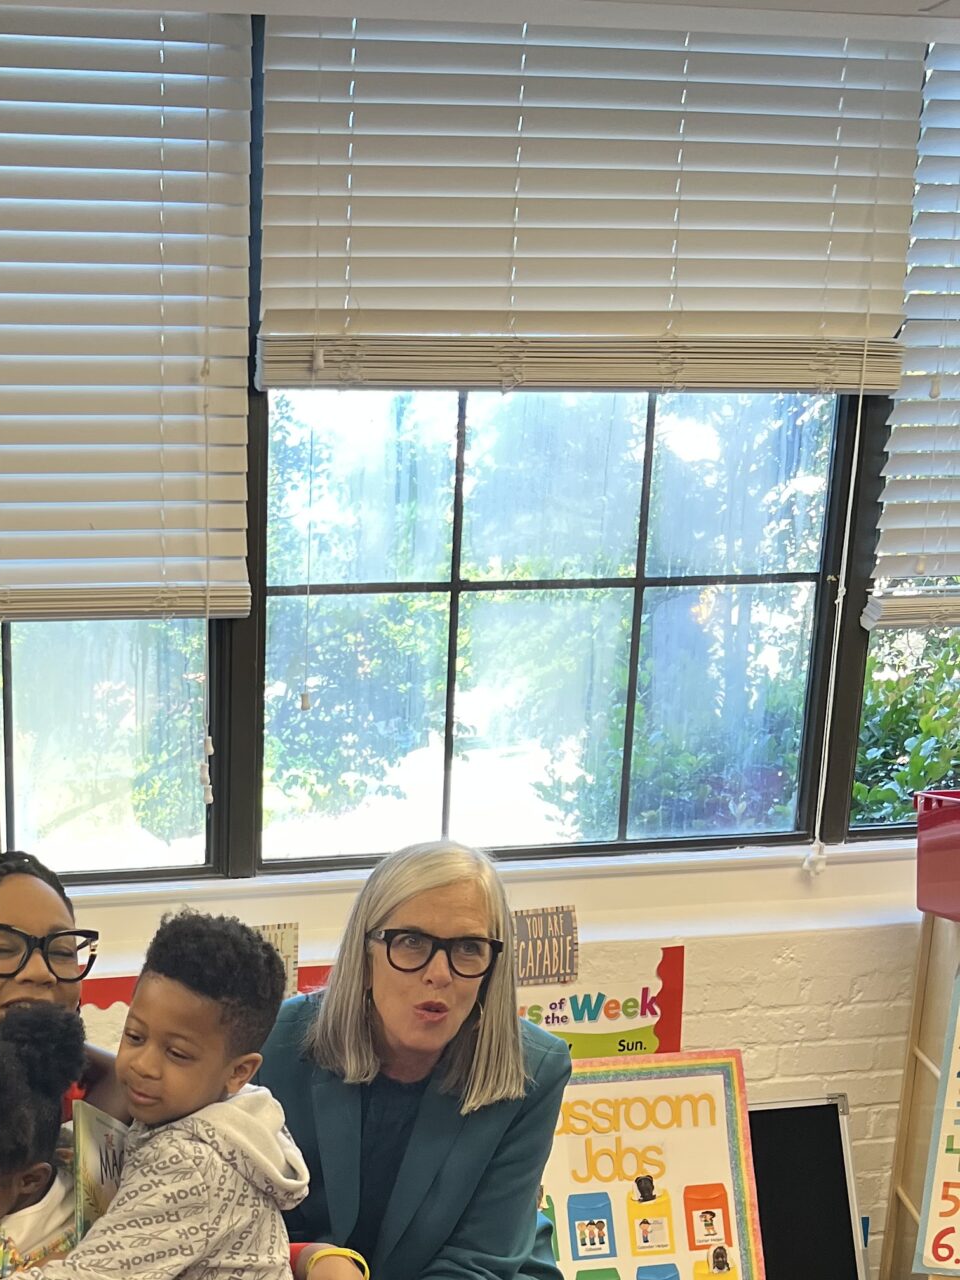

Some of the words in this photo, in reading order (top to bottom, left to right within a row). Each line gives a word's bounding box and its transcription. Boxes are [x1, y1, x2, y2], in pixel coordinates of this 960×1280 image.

[526, 915, 543, 938] YOU
[547, 913, 564, 936] ARE
[518, 936, 572, 979] CAPABLE
[549, 998, 565, 1012] of
[569, 986, 659, 1023] Week
[544, 1012, 568, 1025] the
[617, 1039, 647, 1052] Sun.
[555, 1093, 717, 1136] assroom
[571, 1136, 667, 1183] Jobs
[100, 1210, 182, 1236] Reebok
[118, 1244, 195, 1270] Reebok
